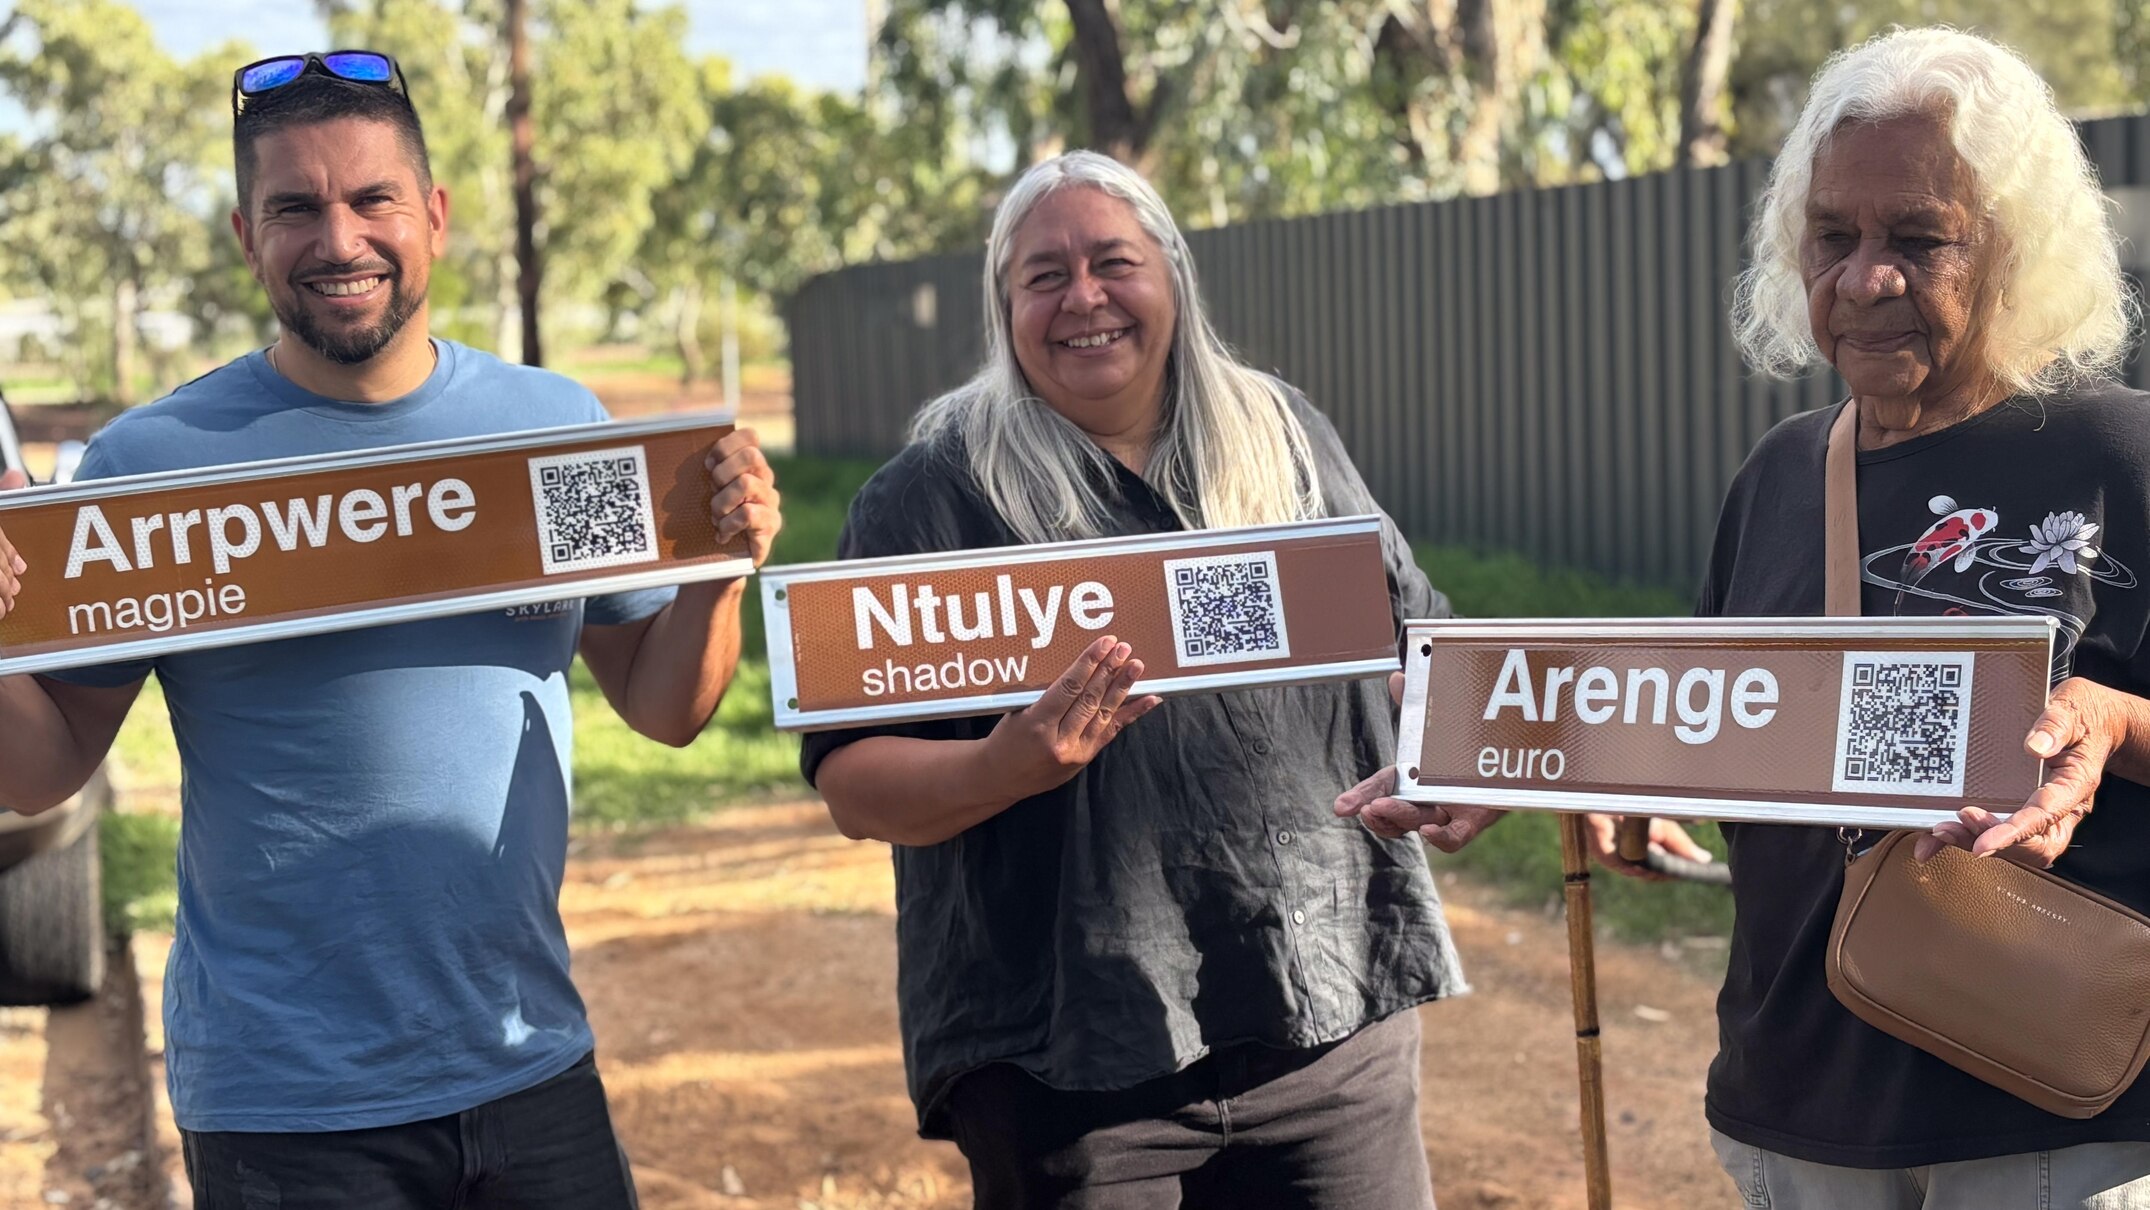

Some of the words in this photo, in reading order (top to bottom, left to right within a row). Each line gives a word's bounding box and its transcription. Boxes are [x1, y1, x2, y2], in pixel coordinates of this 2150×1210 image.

[64, 478, 477, 578] Arrpwere
[68, 577, 247, 636] magpie
[852, 574, 1115, 650] Ntulye
[862, 652, 1029, 698] shadow
[1482, 647, 1780, 746] Arenge
[1476, 745, 1567, 782] euro
